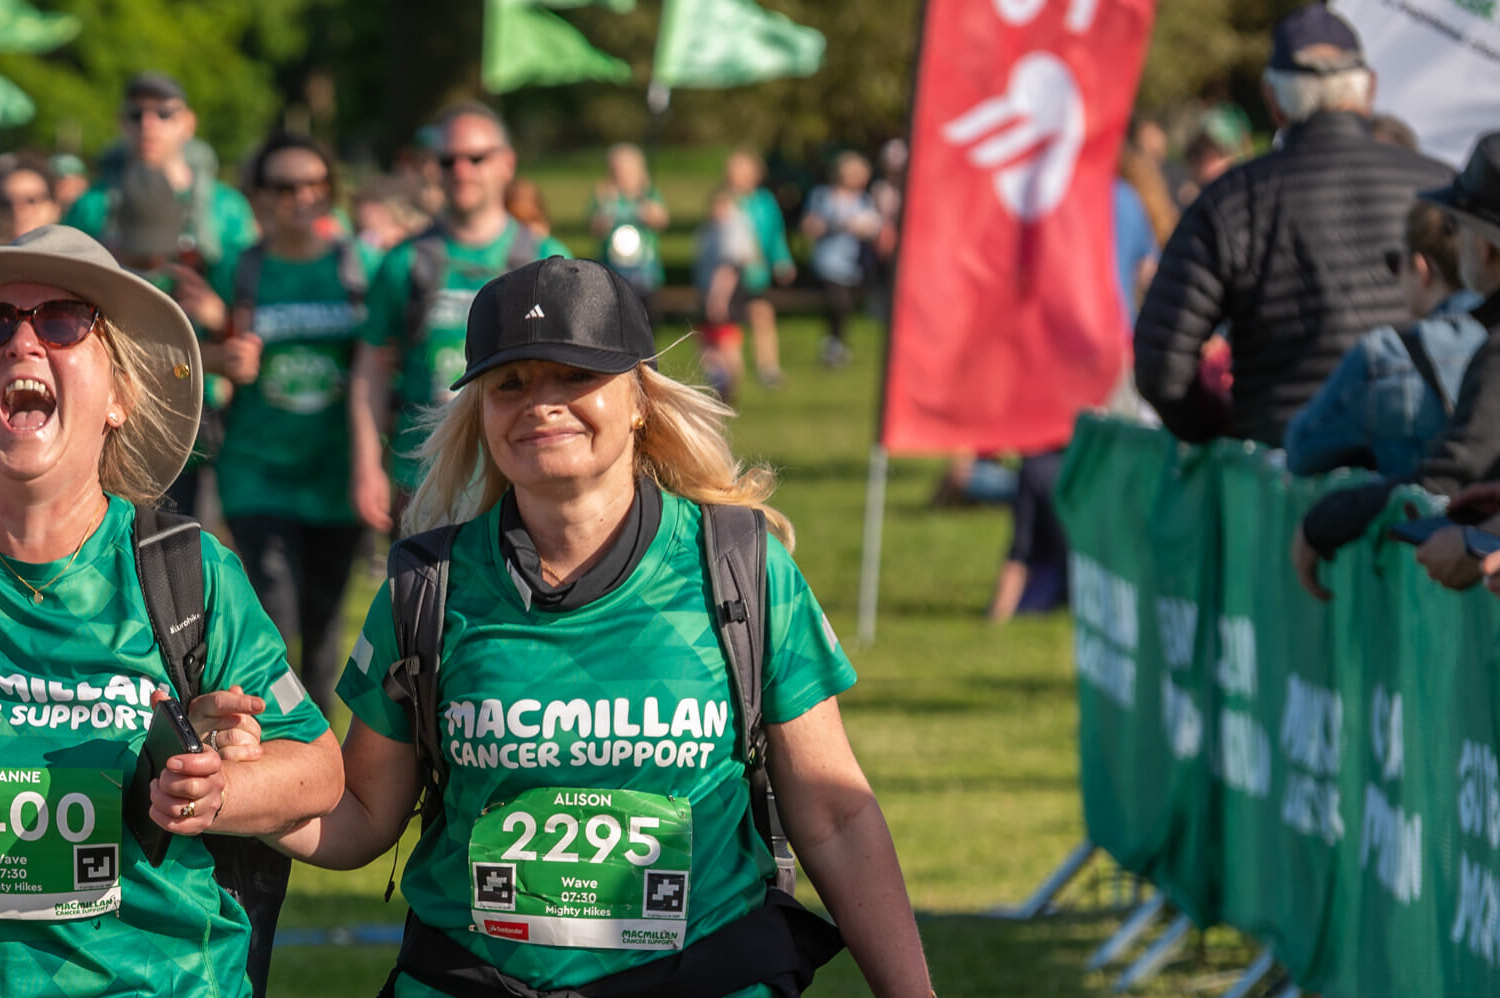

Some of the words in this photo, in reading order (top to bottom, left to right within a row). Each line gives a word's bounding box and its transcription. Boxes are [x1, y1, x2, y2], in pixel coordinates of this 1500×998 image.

[9, 703, 153, 730] SUPPORT
[444, 697, 728, 738] MACMILLAN
[450, 740, 561, 769] CANCER
[570, 739, 715, 769] SUPPORT
[554, 792, 612, 807] ALISON
[500, 811, 661, 866] 2295
[14, 882, 43, 892] Hikes
[561, 876, 598, 889] Wave
[561, 892, 597, 904] 07:30
[54, 899, 113, 911] MACMILLAN
[545, 905, 580, 917] Mighty
[583, 905, 611, 917] Hikes
[621, 930, 678, 939] MACMILLAN
